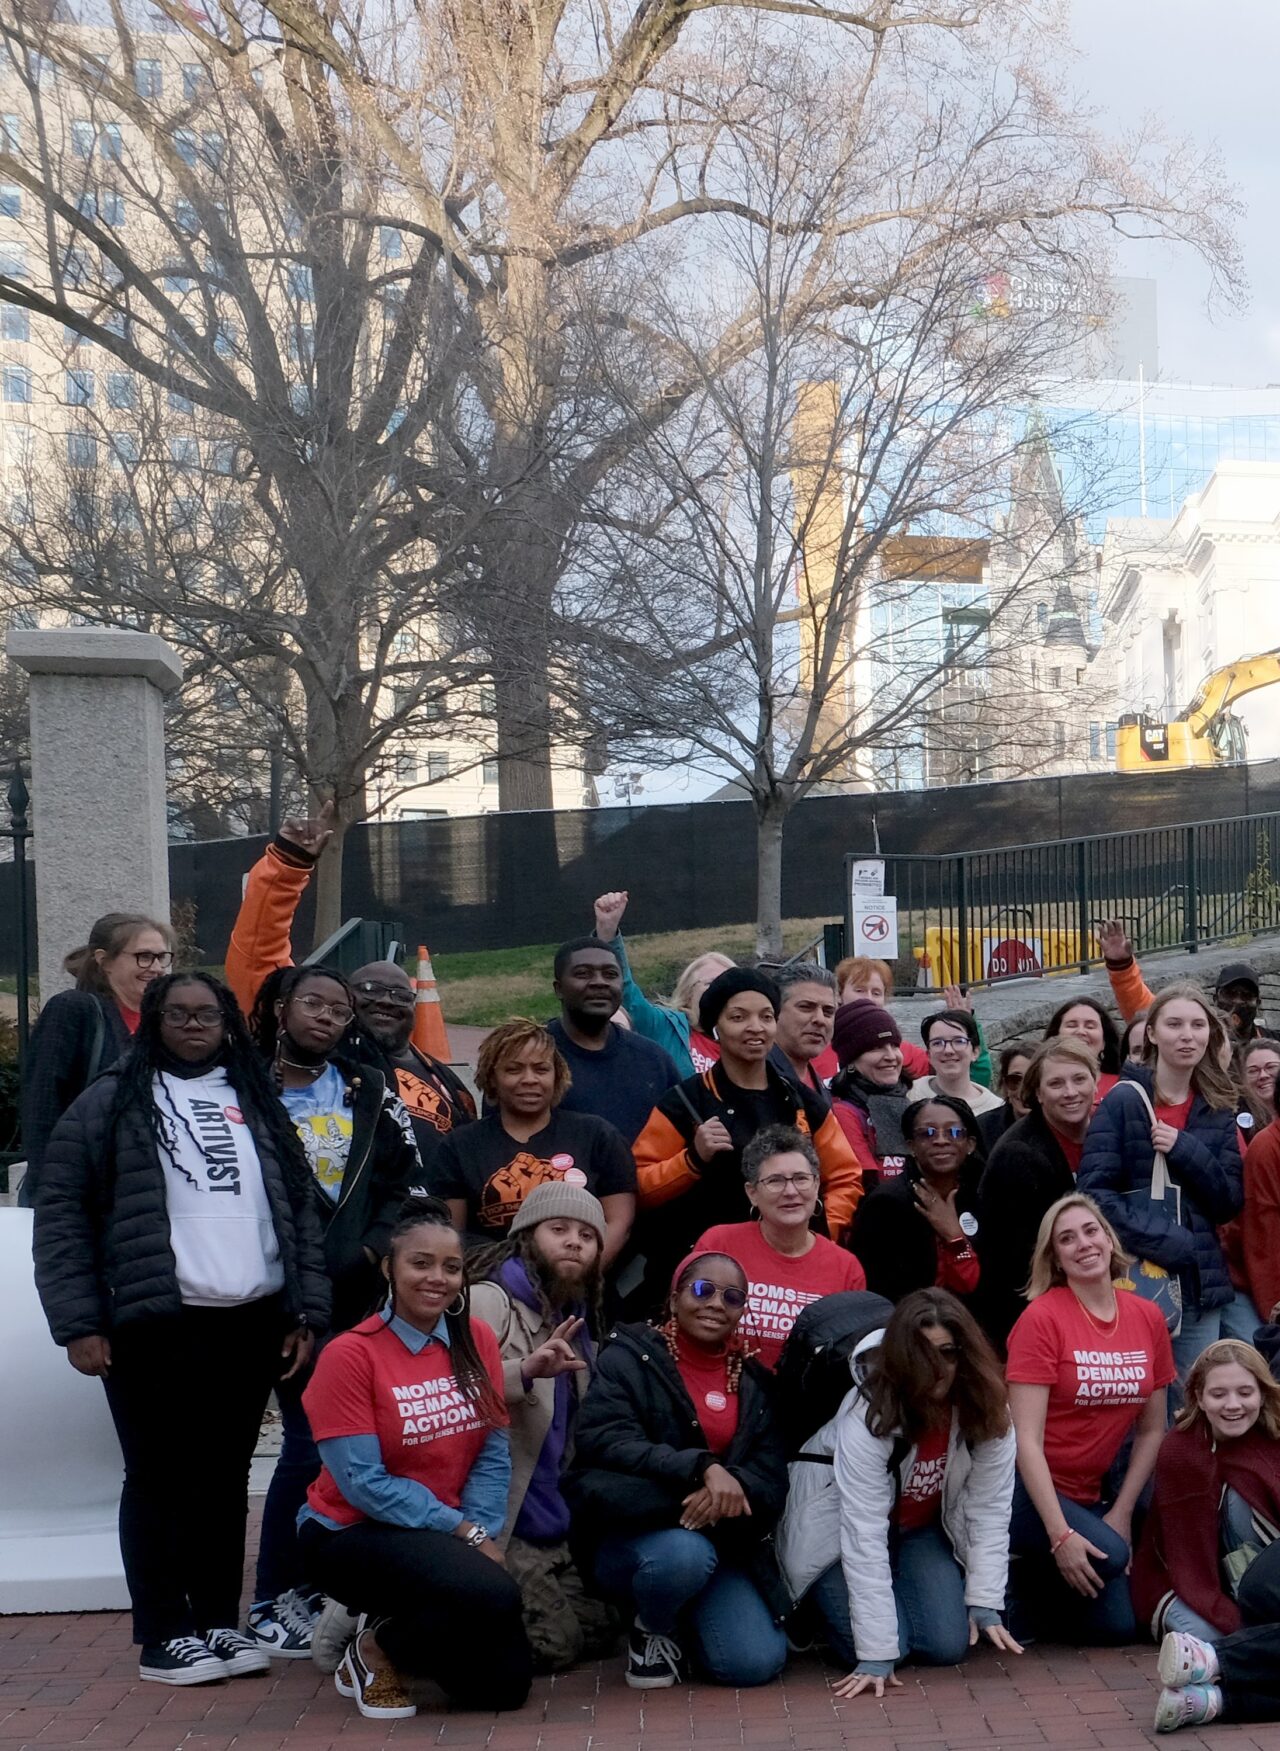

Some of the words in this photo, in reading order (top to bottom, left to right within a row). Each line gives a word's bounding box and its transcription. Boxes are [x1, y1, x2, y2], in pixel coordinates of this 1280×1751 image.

[1145, 729, 1165, 742] CAT
[992, 957, 1007, 973] DO
[187, 1098, 241, 1196] ARTIVIST
[744, 1297, 805, 1318] EMAN
[762, 1330, 785, 1341] SENSE
[1073, 1350, 1124, 1366] MOMS
[1076, 1366, 1146, 1381] DEMAND
[392, 1377, 452, 1401] MOMS
[1076, 1382, 1140, 1397] ACTION
[1074, 1398, 1089, 1406] FOR
[402, 1403, 476, 1435] ACTION
[402, 1436, 419, 1446] FOR
